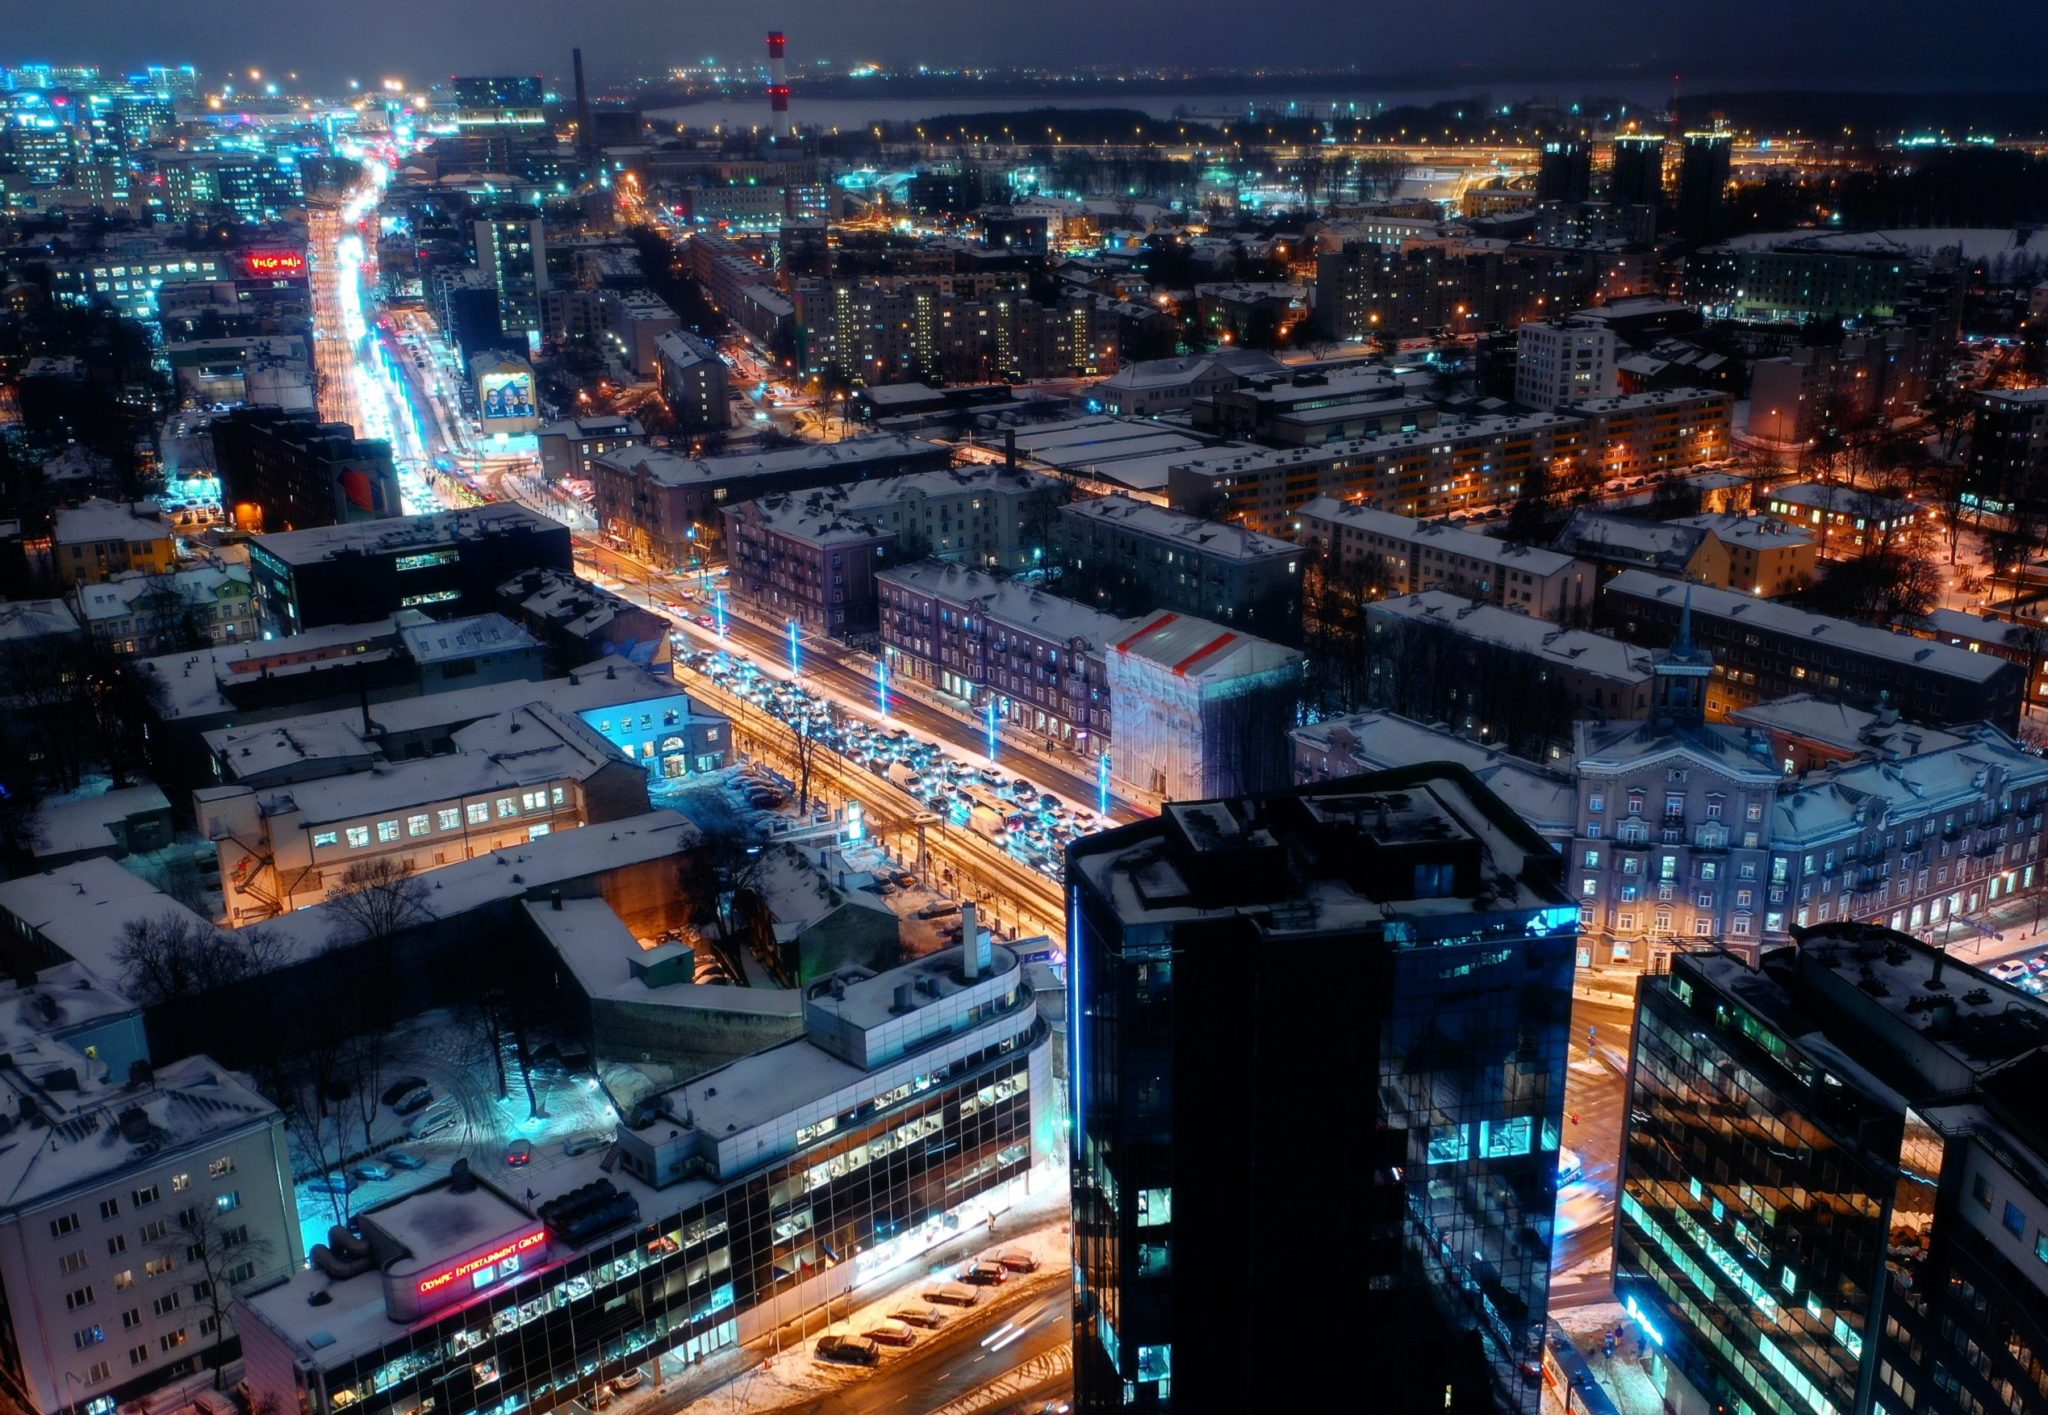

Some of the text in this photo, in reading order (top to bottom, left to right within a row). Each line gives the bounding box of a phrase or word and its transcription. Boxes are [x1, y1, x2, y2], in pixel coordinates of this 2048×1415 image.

[420, 1232, 545, 1292] OLYMPIC ENTERTAINMENT GROUP
